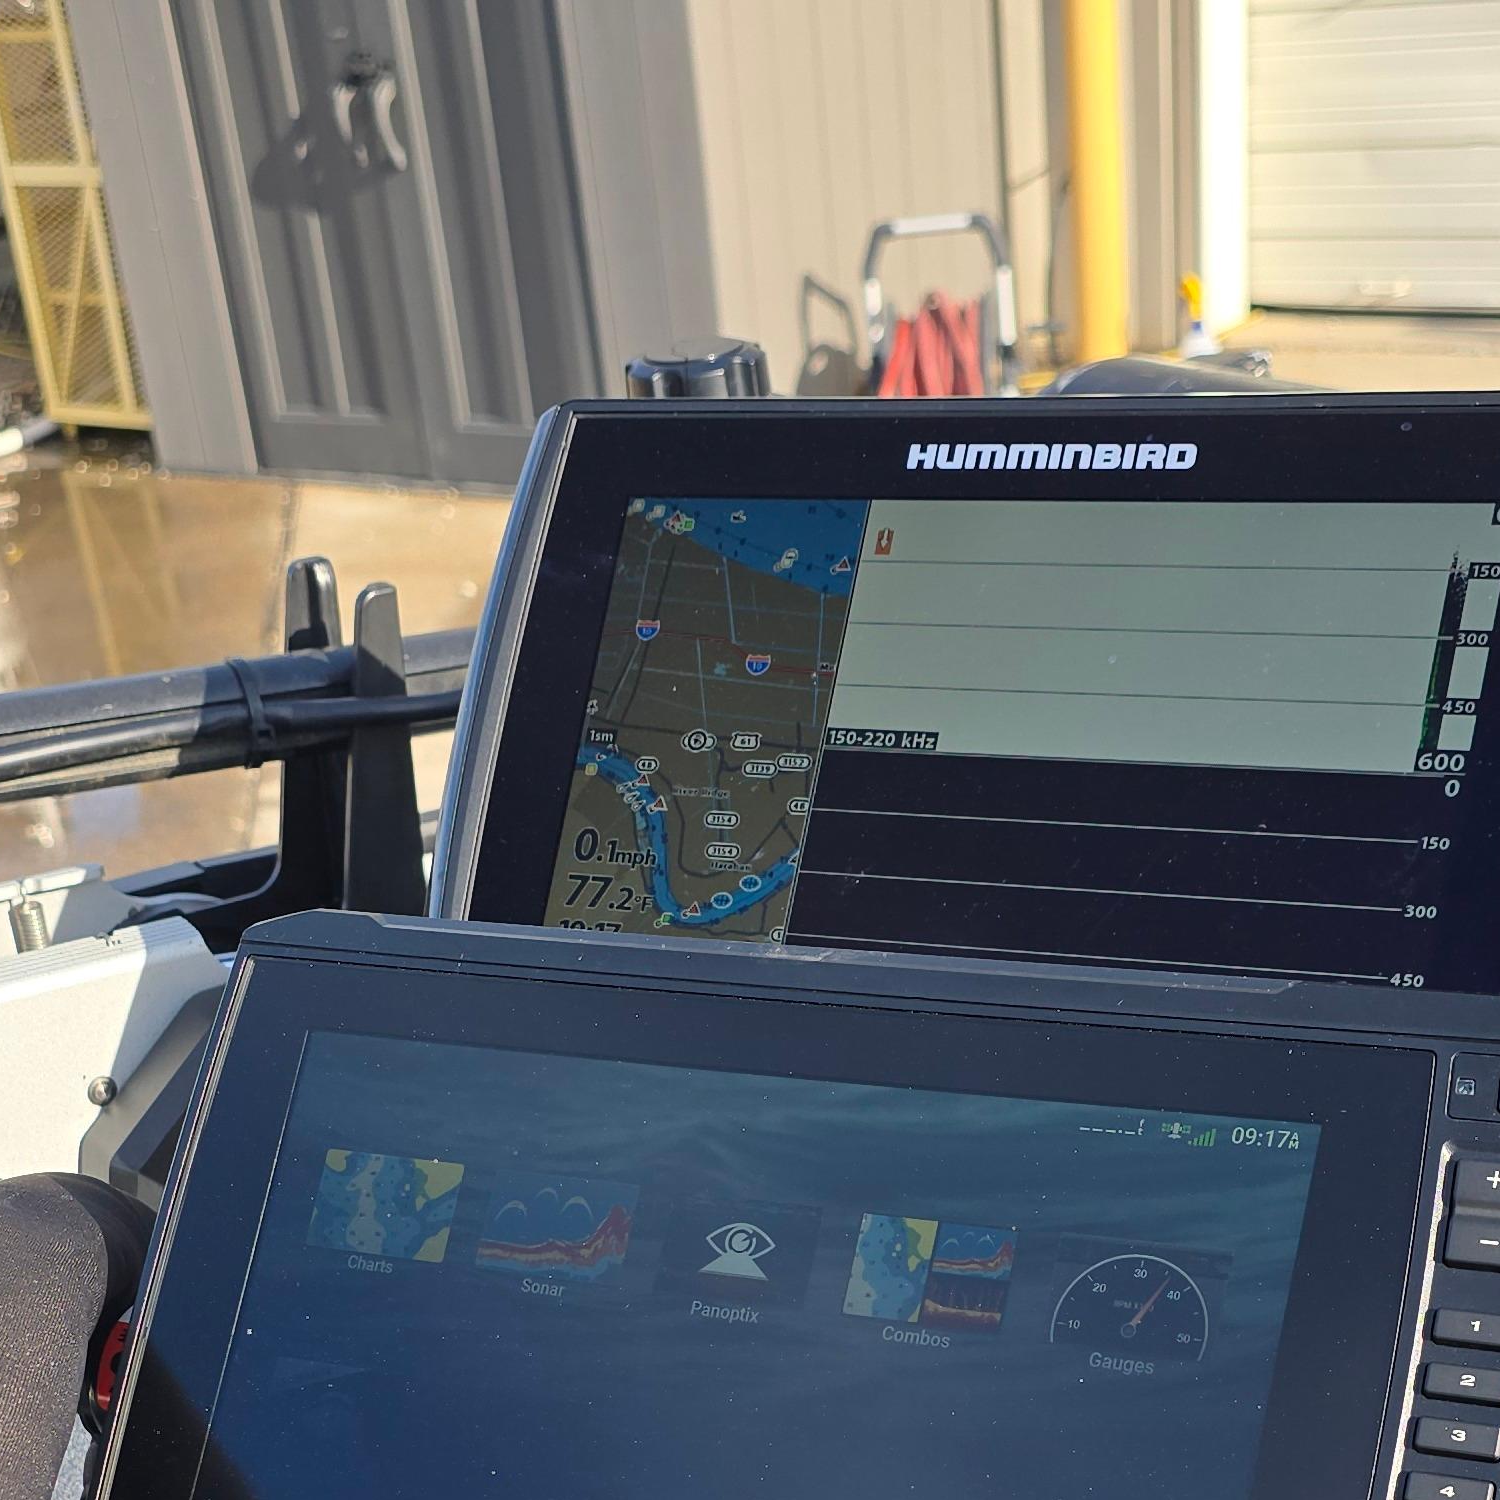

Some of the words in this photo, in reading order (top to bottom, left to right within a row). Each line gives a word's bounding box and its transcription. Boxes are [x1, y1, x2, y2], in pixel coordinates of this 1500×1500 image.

[906, 443, 1198, 470] HUMMINBIRD
[1472, 564, 1500, 578] 150
[1456, 633, 1489, 646] 300
[1442, 700, 1476, 714] 450
[590, 730, 613, 742] 1sm
[829, 730, 896, 747] 150-220
[901, 732, 936, 749] kHz
[1417, 753, 1465, 772] 600
[1444, 779, 1461, 797] 0
[1421, 836, 1450, 851] 150
[1404, 904, 1437, 919] 300
[1389, 972, 1425, 988] 450
[347, 1254, 394, 1274] Charts
[1134, 1269, 1148, 1279] 30
[520, 1278, 565, 1298] Sonar
[1092, 1283, 1107, 1293] 20
[1167, 1291, 1181, 1301] 40
[690, 1301, 760, 1325] Panoptix
[1068, 1319, 1081, 1329] 10
[1470, 1320, 1481, 1332] 1
[881, 1326, 951, 1349] Combos
[1089, 1352, 1154, 1376] Gauges
[1459, 1375, 1476, 1386] 2
[1451, 1430, 1466, 1442] 3
[1439, 1486, 1455, 1497] 4
